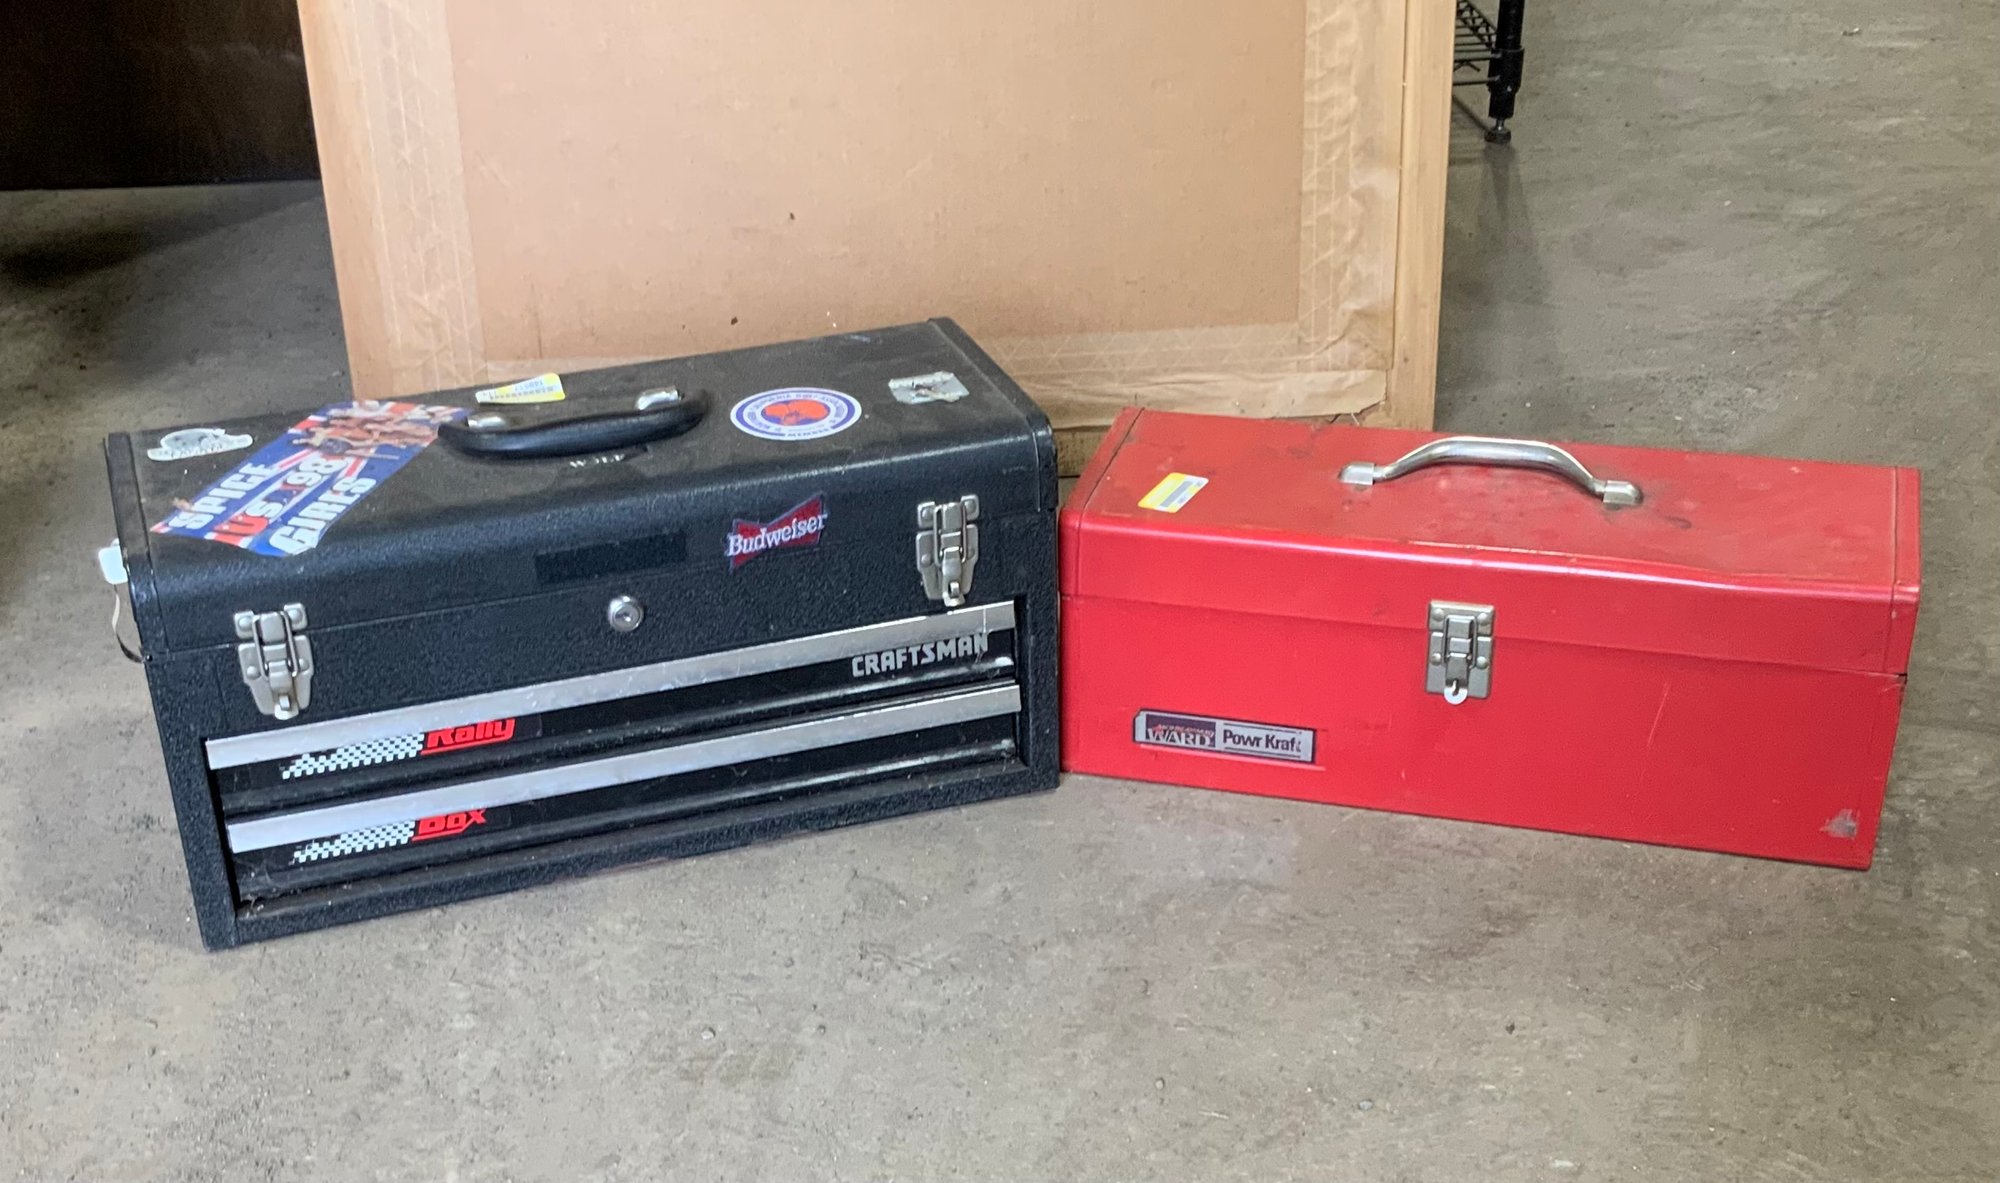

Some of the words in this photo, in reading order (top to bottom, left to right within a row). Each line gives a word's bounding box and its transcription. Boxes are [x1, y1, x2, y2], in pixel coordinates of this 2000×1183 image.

[168, 462, 273, 531] SPICE
[269, 477, 377, 555] GIRLS
[725, 514, 828, 557] Budweiser
[851, 632, 989, 677] CRAFTSMAN
[426, 718, 516, 749] Rally
[1146, 728, 1212, 747] WARD
[1223, 728, 1263, 748] Powr
